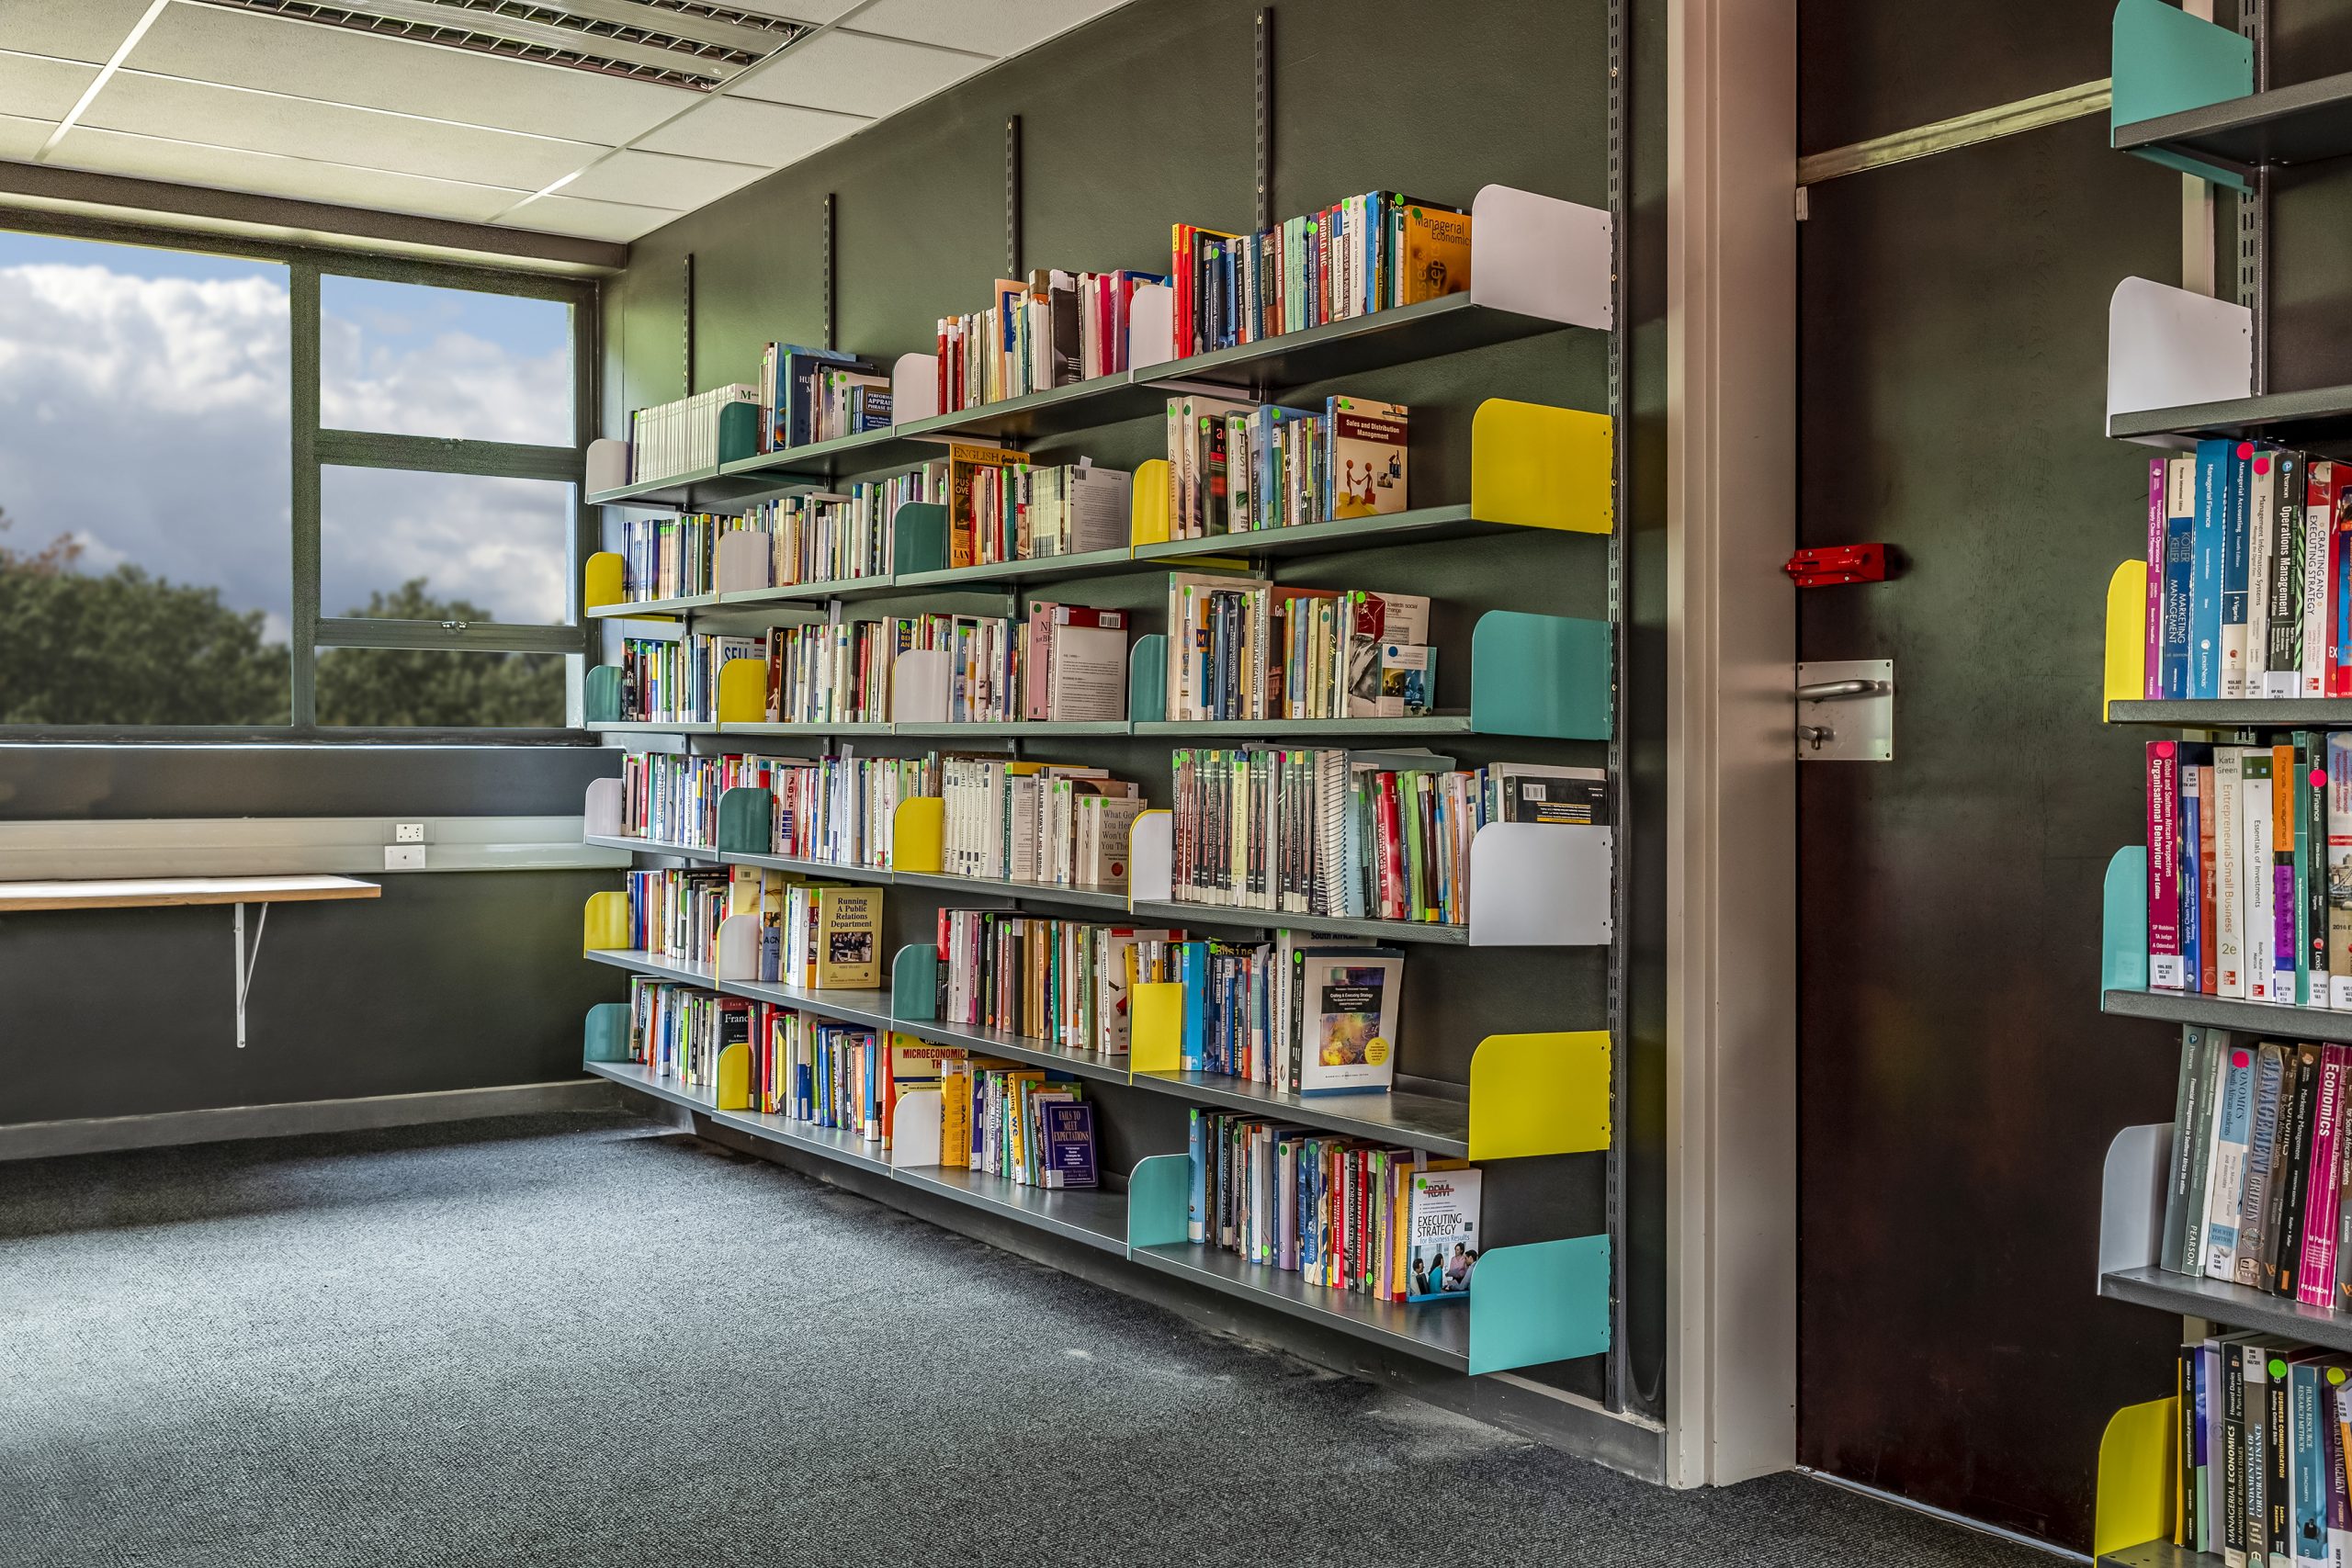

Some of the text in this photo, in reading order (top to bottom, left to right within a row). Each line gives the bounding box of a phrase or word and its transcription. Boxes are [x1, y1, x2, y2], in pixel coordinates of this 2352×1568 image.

[1415, 217, 1464, 236] Managerial
[1346, 419, 1359, 427] Sales
[1372, 423, 1399, 434] Distribution
[1357, 429, 1388, 439] Management
[955, 447, 999, 463] ENGLISH
[1001, 455, 1017, 464] Grade
[2205, 464, 2213, 500] Managerial
[2237, 462, 2245, 501] Managerial
[2235, 502, 2245, 533] Accounting
[2257, 496, 2266, 537] Management
[2279, 506, 2291, 555] Operations
[2170, 537, 2179, 563] KELLER
[2181, 532, 2191, 562] KOTLER
[2256, 539, 2265, 578] Information
[2307, 514, 2317, 615] EXECUTING STRATEGY
[2316, 530, 2325, 600] CRAFTING AND
[2277, 558, 2290, 616] Management
[2169, 580, 2177, 643] MANAGEMENT
[2177, 593, 2187, 644] MARKETING
[1197, 634, 1204, 644] M
[2200, 652, 2209, 687] LexisNexis
[1103, 810, 1135, 819] What Got
[2153, 760, 2164, 869] Organisational Behaviour
[1103, 821, 1116, 829] You
[1102, 831, 1121, 840] Won't
[2223, 784, 2234, 933] Entrepreneurial Small Business
[838, 897, 867, 906] Running
[831, 920, 872, 929] Department
[1311, 931, 1331, 940] South
[2222, 943, 2237, 955] 2e
[903, 1049, 966, 1059] MICROECONOMIC
[2188, 1077, 2197, 1099] Financial
[2223, 1067, 2239, 1135] South African students
[2319, 1063, 2339, 1136] Economics
[1058, 1111, 1080, 1121] FAILS TO
[2184, 1100, 2195, 1130] Management
[2278, 1102, 2287, 1119] South
[1012, 1116, 1019, 1136] we
[1064, 1122, 1077, 1131] MEET
[2276, 1120, 2286, 1142] African
[2294, 1089, 2308, 1159] Marketing Management
[1054, 1132, 1089, 1142] EXPECTATIONS
[2182, 1136, 2191, 1156] Southern
[2245, 1057, 2282, 1222] MANAGEMENT GRIFFIN
[2273, 1143, 2283, 1168] students
[1418, 1213, 1462, 1226] EXECUTING
[1418, 1224, 1456, 1237] STRATEGY
[1451, 1234, 1470, 1242] Results
[2187, 1224, 2198, 1266] PEARSON
[2301, 1283, 2329, 1294] PEARSON
[2247, 1433, 2254, 1443] OF
[2238, 1535, 2243, 1546] AN
